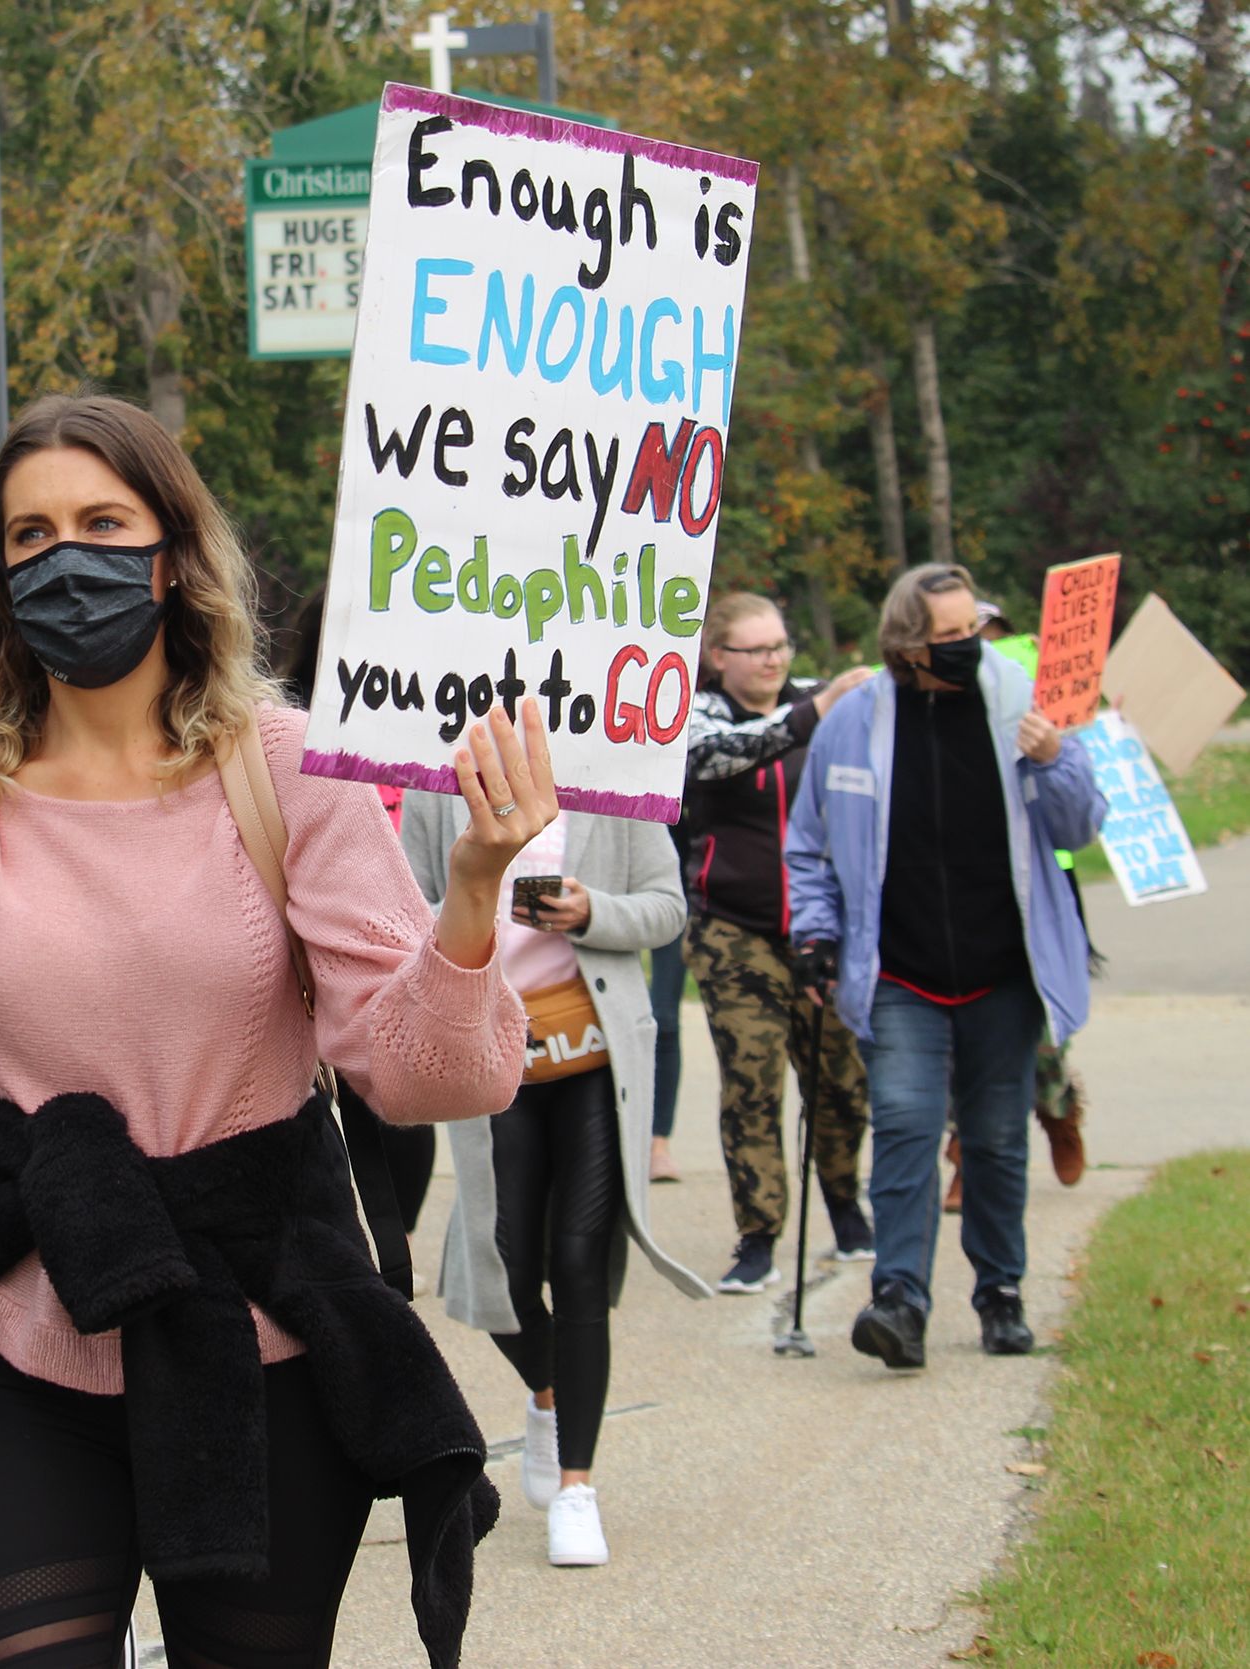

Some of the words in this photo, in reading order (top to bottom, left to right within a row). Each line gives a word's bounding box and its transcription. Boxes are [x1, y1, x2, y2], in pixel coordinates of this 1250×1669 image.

[263, 166, 369, 199] Christian
[407, 115, 657, 290] Enough
[694, 176, 744, 266] is
[284, 218, 356, 244] HUGE
[410, 258, 735, 427] ENOUGH
[501, 417, 619, 561] say
[621, 417, 724, 537] NO
[369, 507, 703, 644] Pedophile
[1061, 565, 1104, 596] CHILD
[1052, 591, 1098, 624] LIVES
[1044, 619, 1097, 654] MATTER
[336, 656, 425, 726] you
[435, 647, 526, 744] got
[539, 648, 597, 735] to
[604, 644, 691, 745] GO
[524, 1024, 607, 1069] FILA
